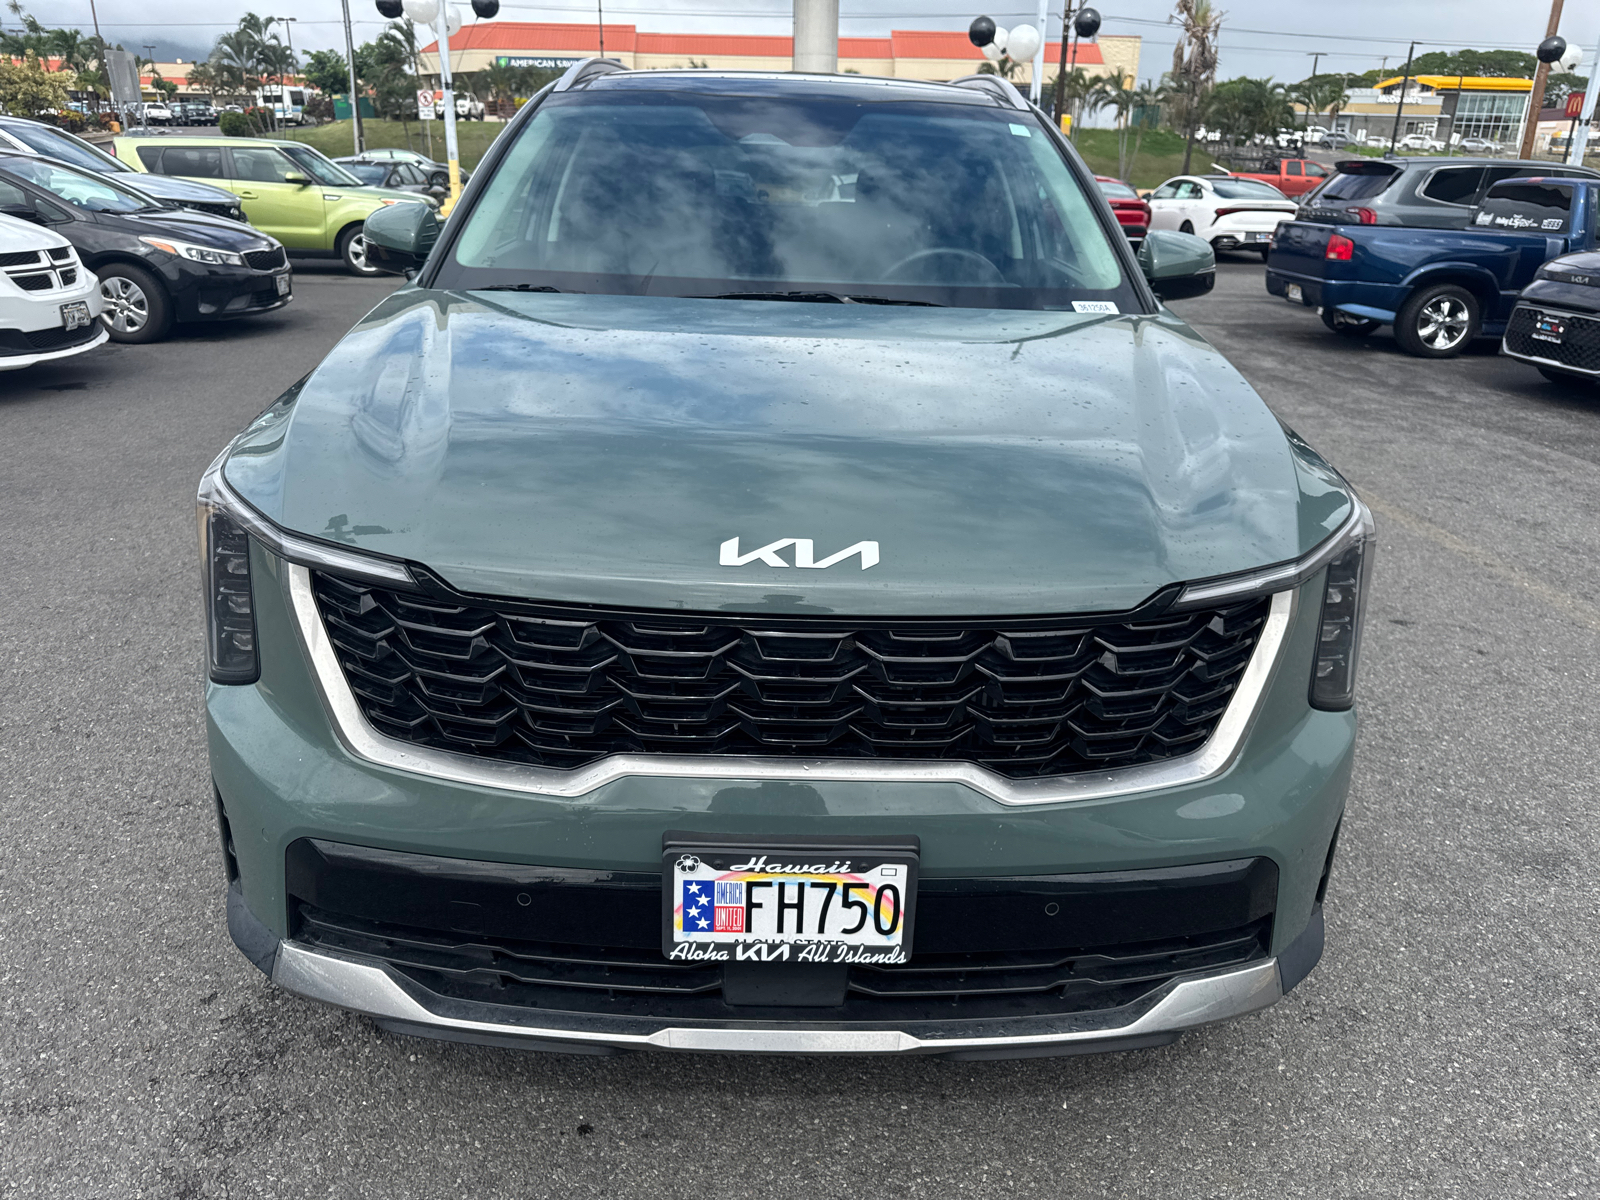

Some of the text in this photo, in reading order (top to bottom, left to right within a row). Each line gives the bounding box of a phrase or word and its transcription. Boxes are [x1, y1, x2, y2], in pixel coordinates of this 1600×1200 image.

[510, 58, 556, 68] AMERICAN
[719, 536, 880, 571] KIA
[729, 855, 852, 874] Hawaii
[716, 882, 743, 905] AMERICA
[715, 907, 743, 927] UNITED
[745, 881, 901, 936] FH750
[669, 942, 907, 963] Aloha KIA All Islands
